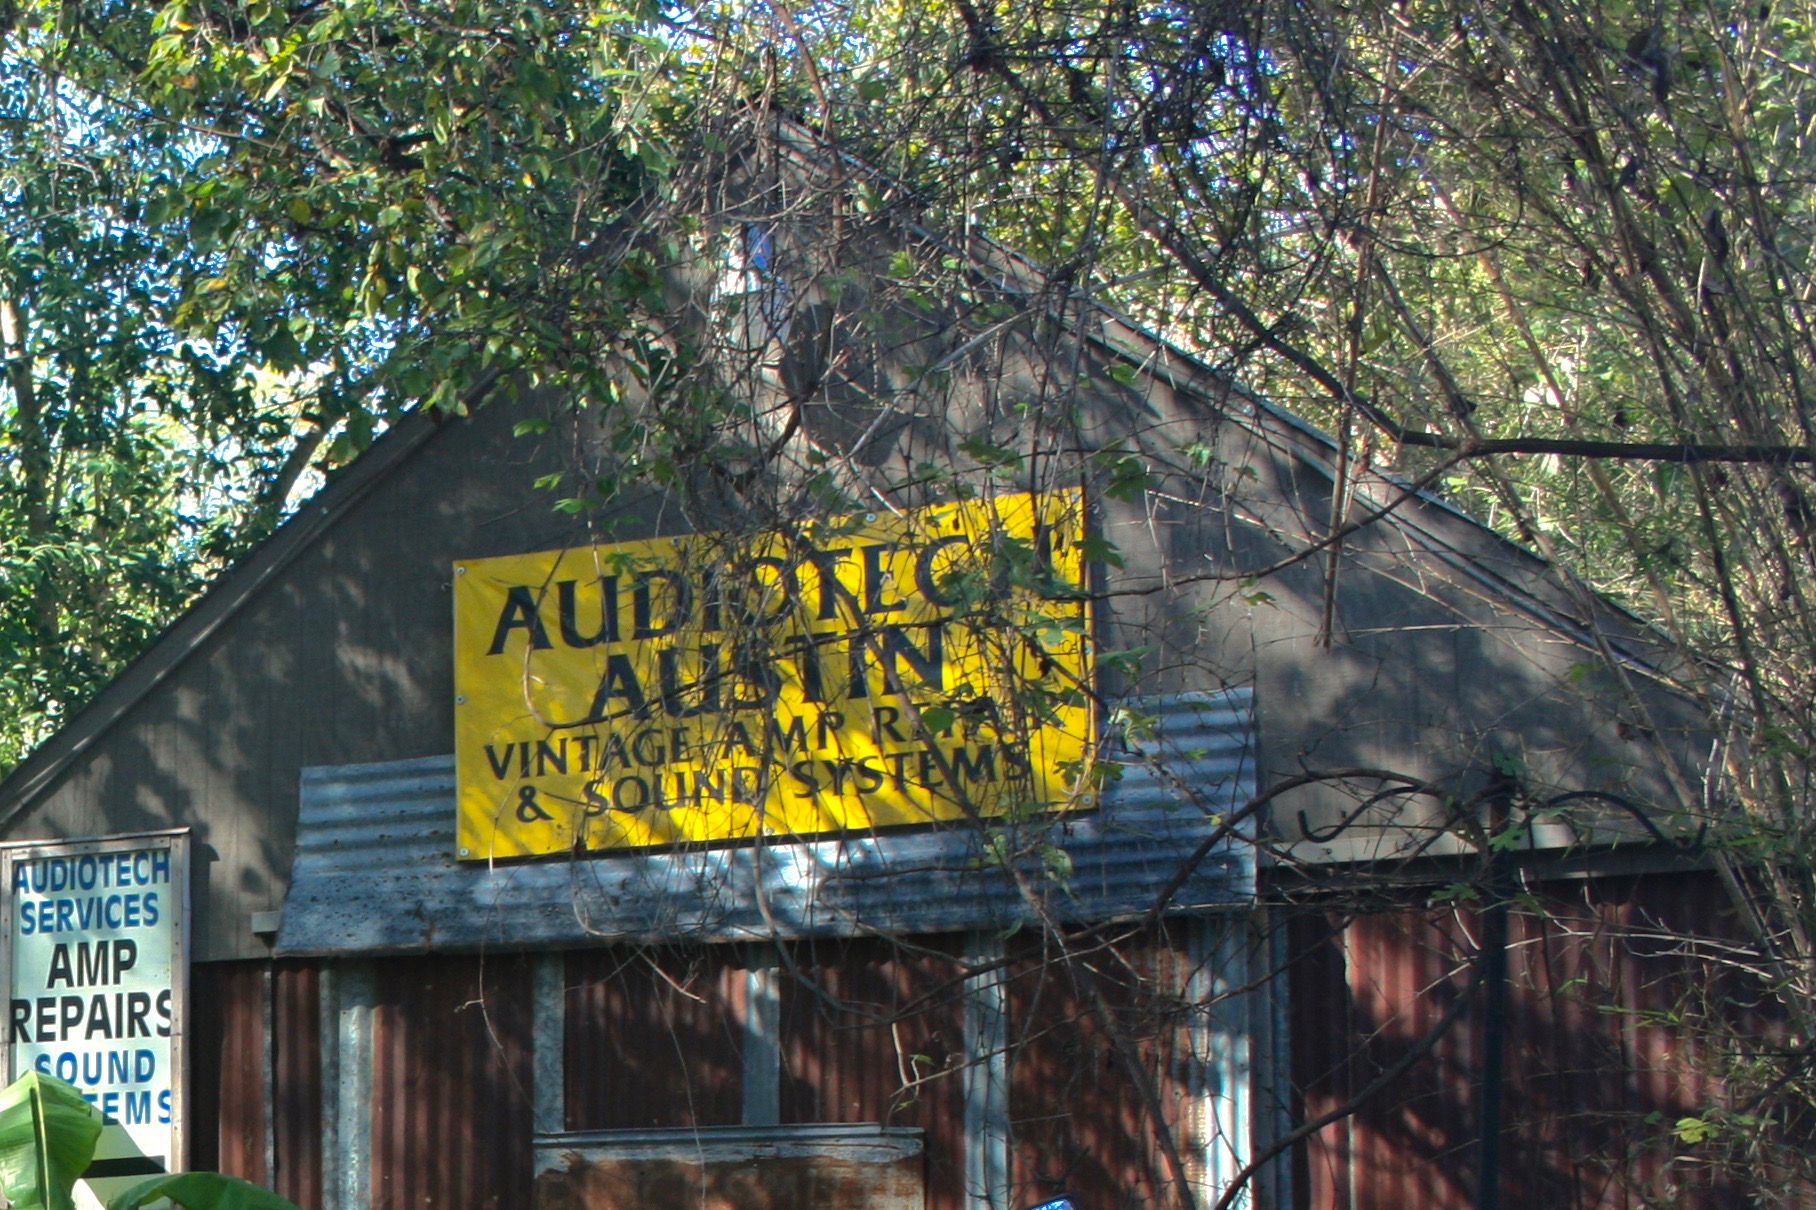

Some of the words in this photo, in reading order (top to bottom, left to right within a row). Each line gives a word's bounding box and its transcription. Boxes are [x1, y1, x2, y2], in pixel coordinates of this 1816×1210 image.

[588, 624, 948, 720] AUSTIN
[484, 726, 693, 780] VINTAGE
[722, 711, 845, 759] AMP
[515, 785, 555, 823] &
[583, 766, 764, 817] SOUND
[789, 741, 1031, 798] SYSTEMS
[12, 851, 170, 895] AUDIOTECH
[20, 892, 159, 936] SERVICES
[47, 938, 138, 989] AMP
[10, 988, 171, 1043] REPAIRS
[35, 1049, 156, 1086] SOUND
